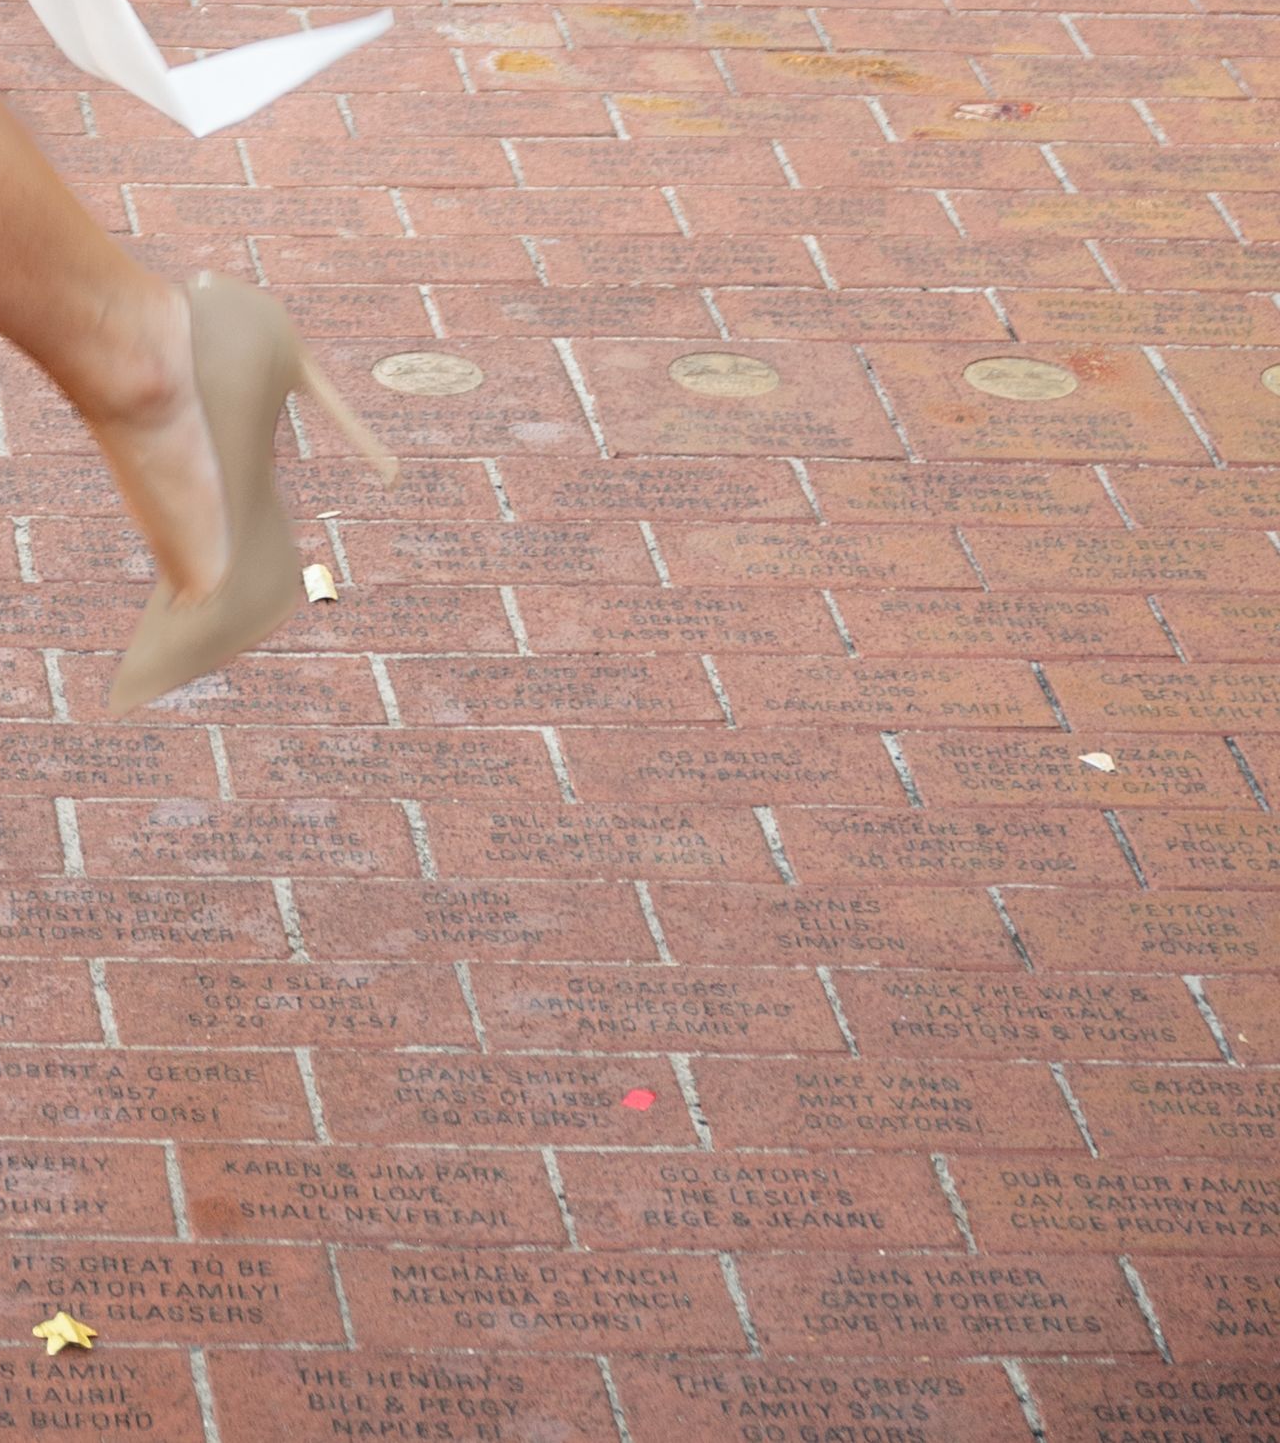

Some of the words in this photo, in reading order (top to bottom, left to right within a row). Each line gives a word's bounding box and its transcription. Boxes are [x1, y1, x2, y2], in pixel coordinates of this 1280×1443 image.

[1128, 904, 1236, 917] PEYTON
[1137, 923, 1242, 936] FISHER
[1141, 941, 1260, 954] POWERS
[881, 985, 963, 997] WALK
[976, 985, 1028, 998] THE
[1038, 988, 1115, 1000] WALK
[1129, 988, 1150, 1003] &
[924, 1004, 985, 1017] TALK
[1002, 1005, 1052, 1018] THE
[1066, 1008, 1133, 1020] TALK
[889, 1023, 1040, 1038] PRESTONS
[1051, 1026, 1071, 1040] &
[1081, 1027, 1177, 1041] PUGHS
[794, 1075, 864, 1088] MIKE
[878, 1077, 961, 1091] VANN
[798, 1095, 874, 1108] MATT
[891, 1098, 974, 1111] VANN
[222, 1161, 322, 1176] KAREN
[335, 1162, 356, 1179] &
[369, 1166, 425, 1180] JIM
[435, 1167, 508, 1181] PARK
[659, 1166, 701, 1183] GO
[297, 1184, 360, 1199] OUR
[372, 1187, 446, 1202] LOVE
[662, 1189, 718, 1205] THE
[729, 1190, 854, 1206] LESLIE'S
[239, 1204, 327, 1219] SHALL
[345, 1208, 442, 1223] NEVER
[452, 1209, 509, 1226] FAIL
[732, 1212, 751, 1227] &
[767, 1212, 885, 1228] JEANNE
[11, 1256, 69, 1271] IT'S
[79, 1257, 172, 1273] GREAT
[190, 1259, 225, 1276] TO
[237, 1260, 271, 1276] BE
[830, 1270, 913, 1285] JOHN
[924, 1270, 1046, 1285] HARPER
[14, 1280, 33, 1295] A
[46, 1280, 146, 1296] GATOR
[820, 1292, 922, 1308] GATOR
[932, 1293, 1069, 1309] FOREVER
[38, 1302, 94, 1320] THE
[107, 1305, 264, 1322] GLASSERS
[802, 1315, 880, 1332] LOVE
[893, 1316, 948, 1332] THE
[961, 1316, 1102, 1333] GREENES
[27, 1363, 138, 1379] FAMILY
[296, 1369, 347, 1385] THE
[366, 1372, 525, 1391] HENDRY'S
[307, 1394, 370, 1412] BILL
[384, 1397, 405, 1414] &
[419, 1399, 520, 1416] PEGGY
[720, 1402, 831, 1417] FAMILY
[847, 1403, 930, 1419] SAYS
[30, 1412, 154, 1430] BUFORD
